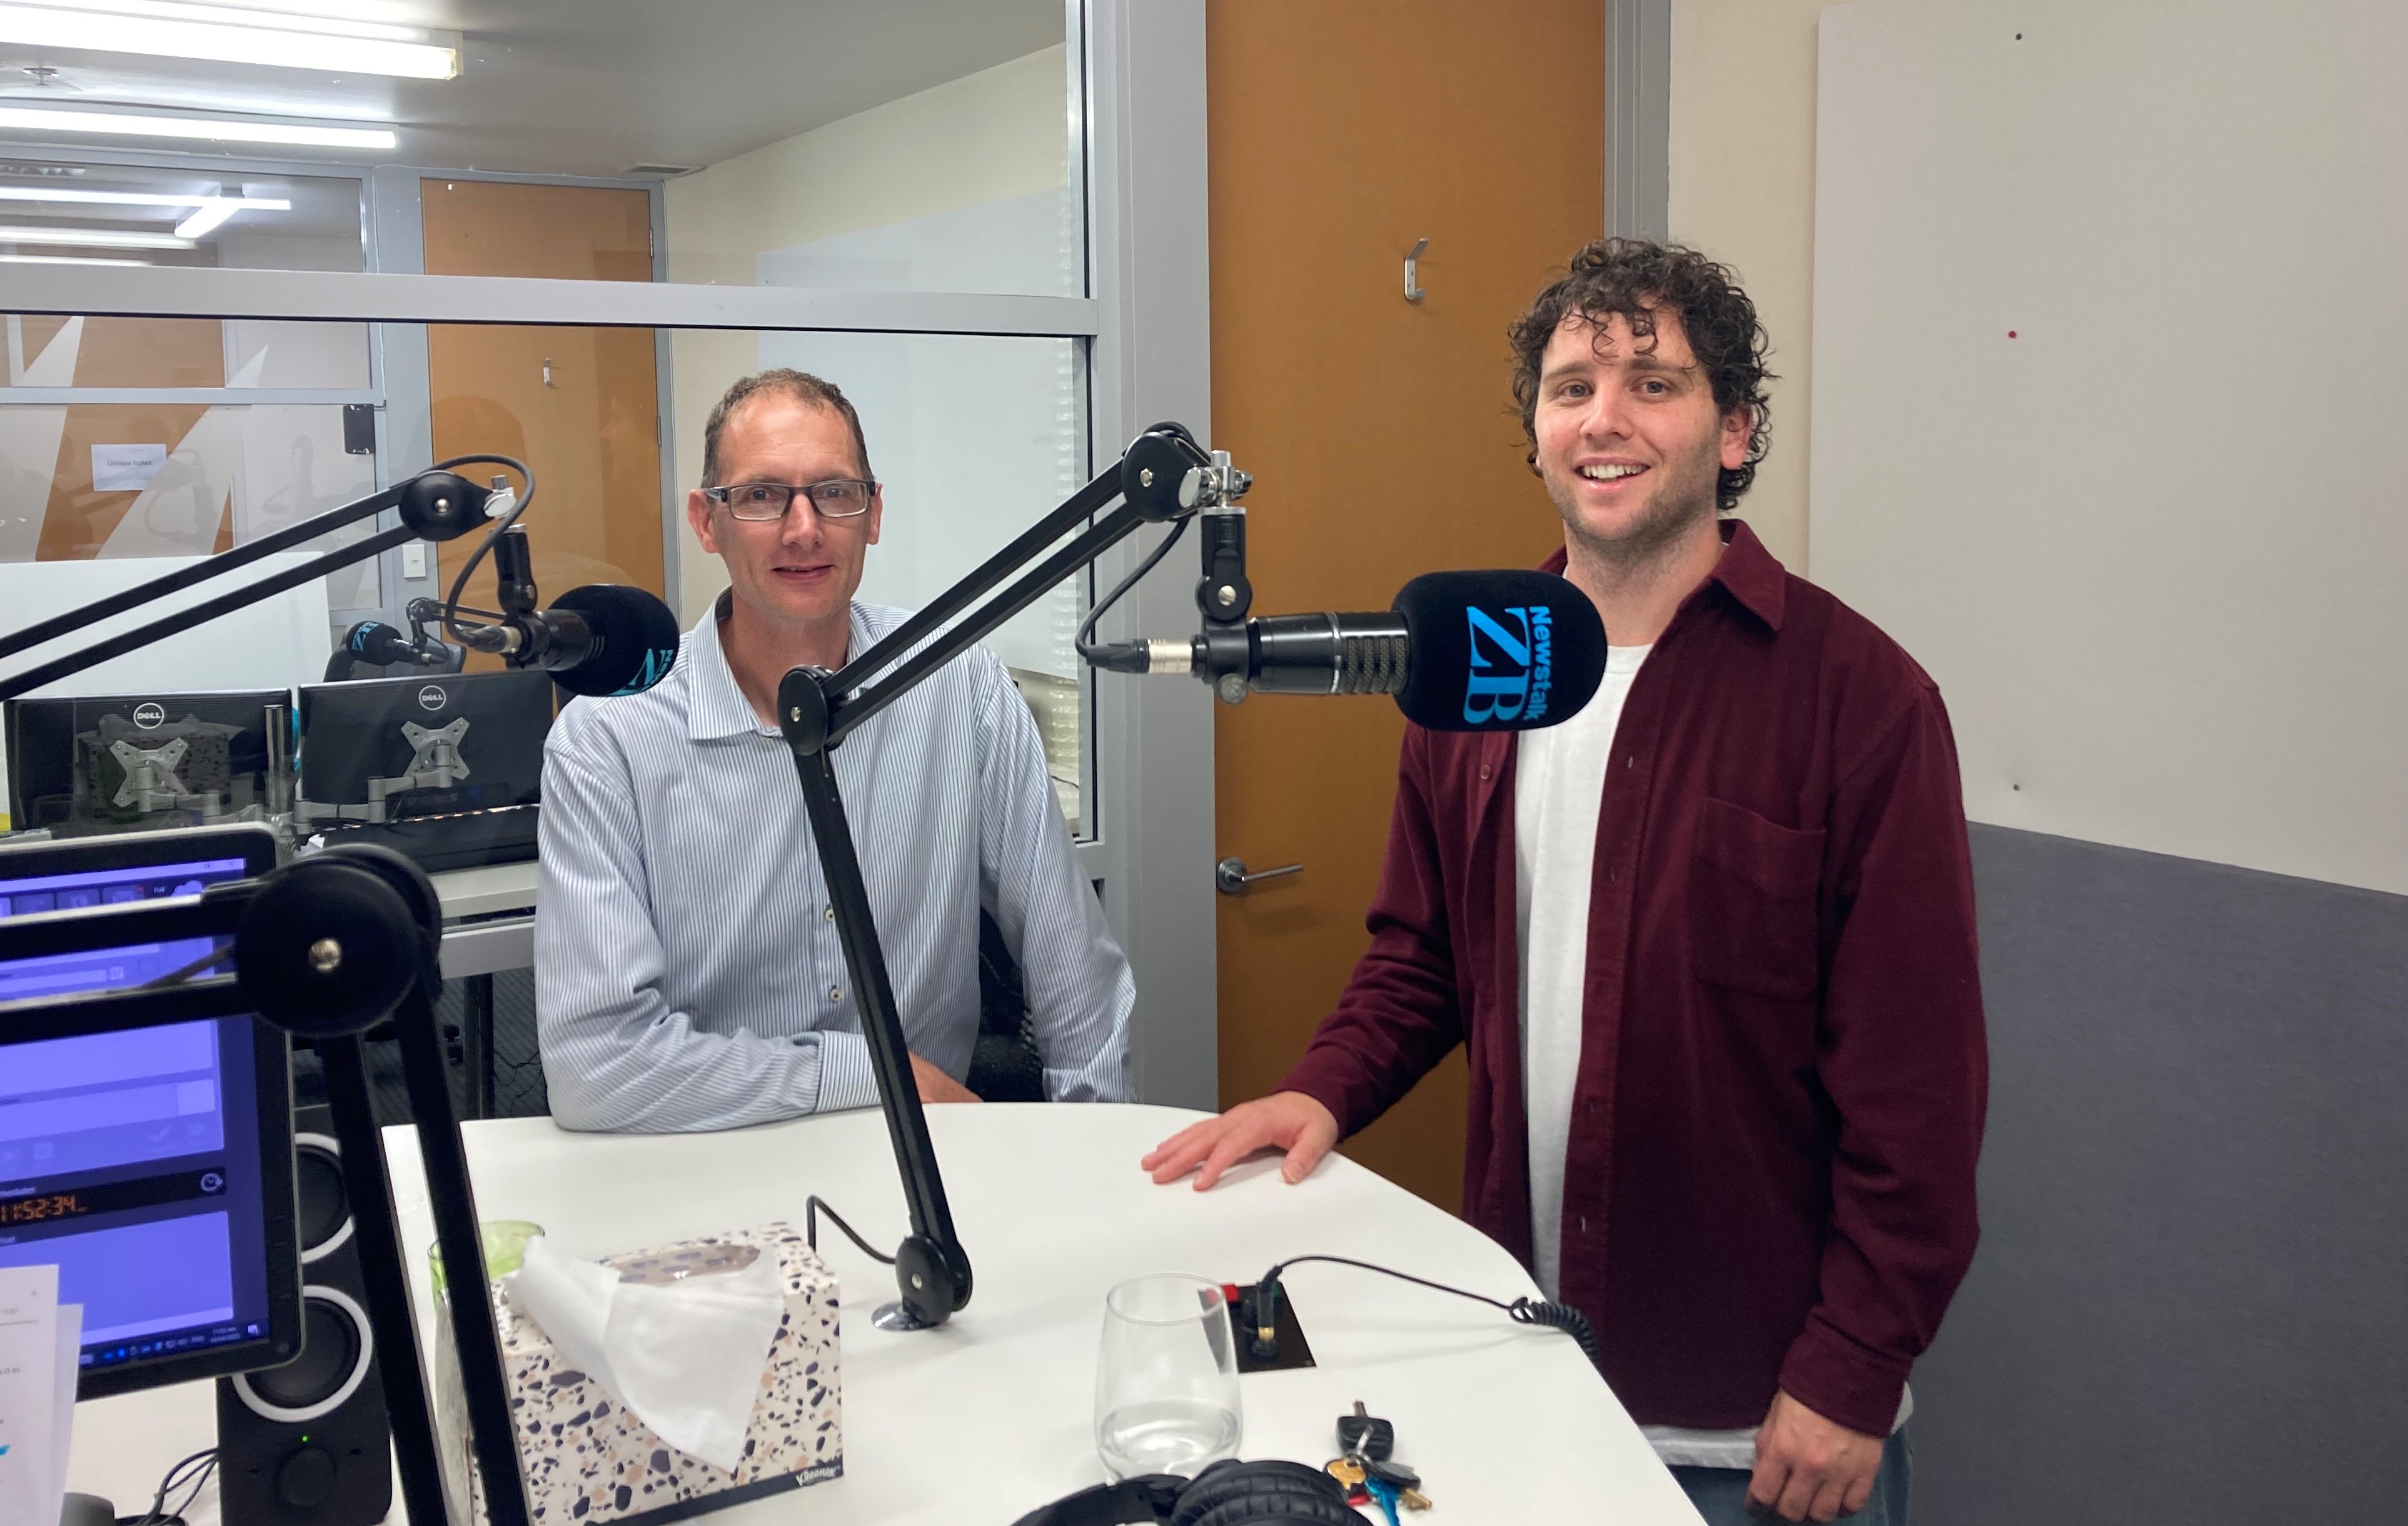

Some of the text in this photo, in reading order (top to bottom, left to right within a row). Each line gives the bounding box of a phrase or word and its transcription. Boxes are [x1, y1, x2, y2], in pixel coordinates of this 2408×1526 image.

[422, 694, 443, 702] DELL
[1463, 605, 1531, 724] ZB
[1523, 605, 1553, 721] Newstalk
